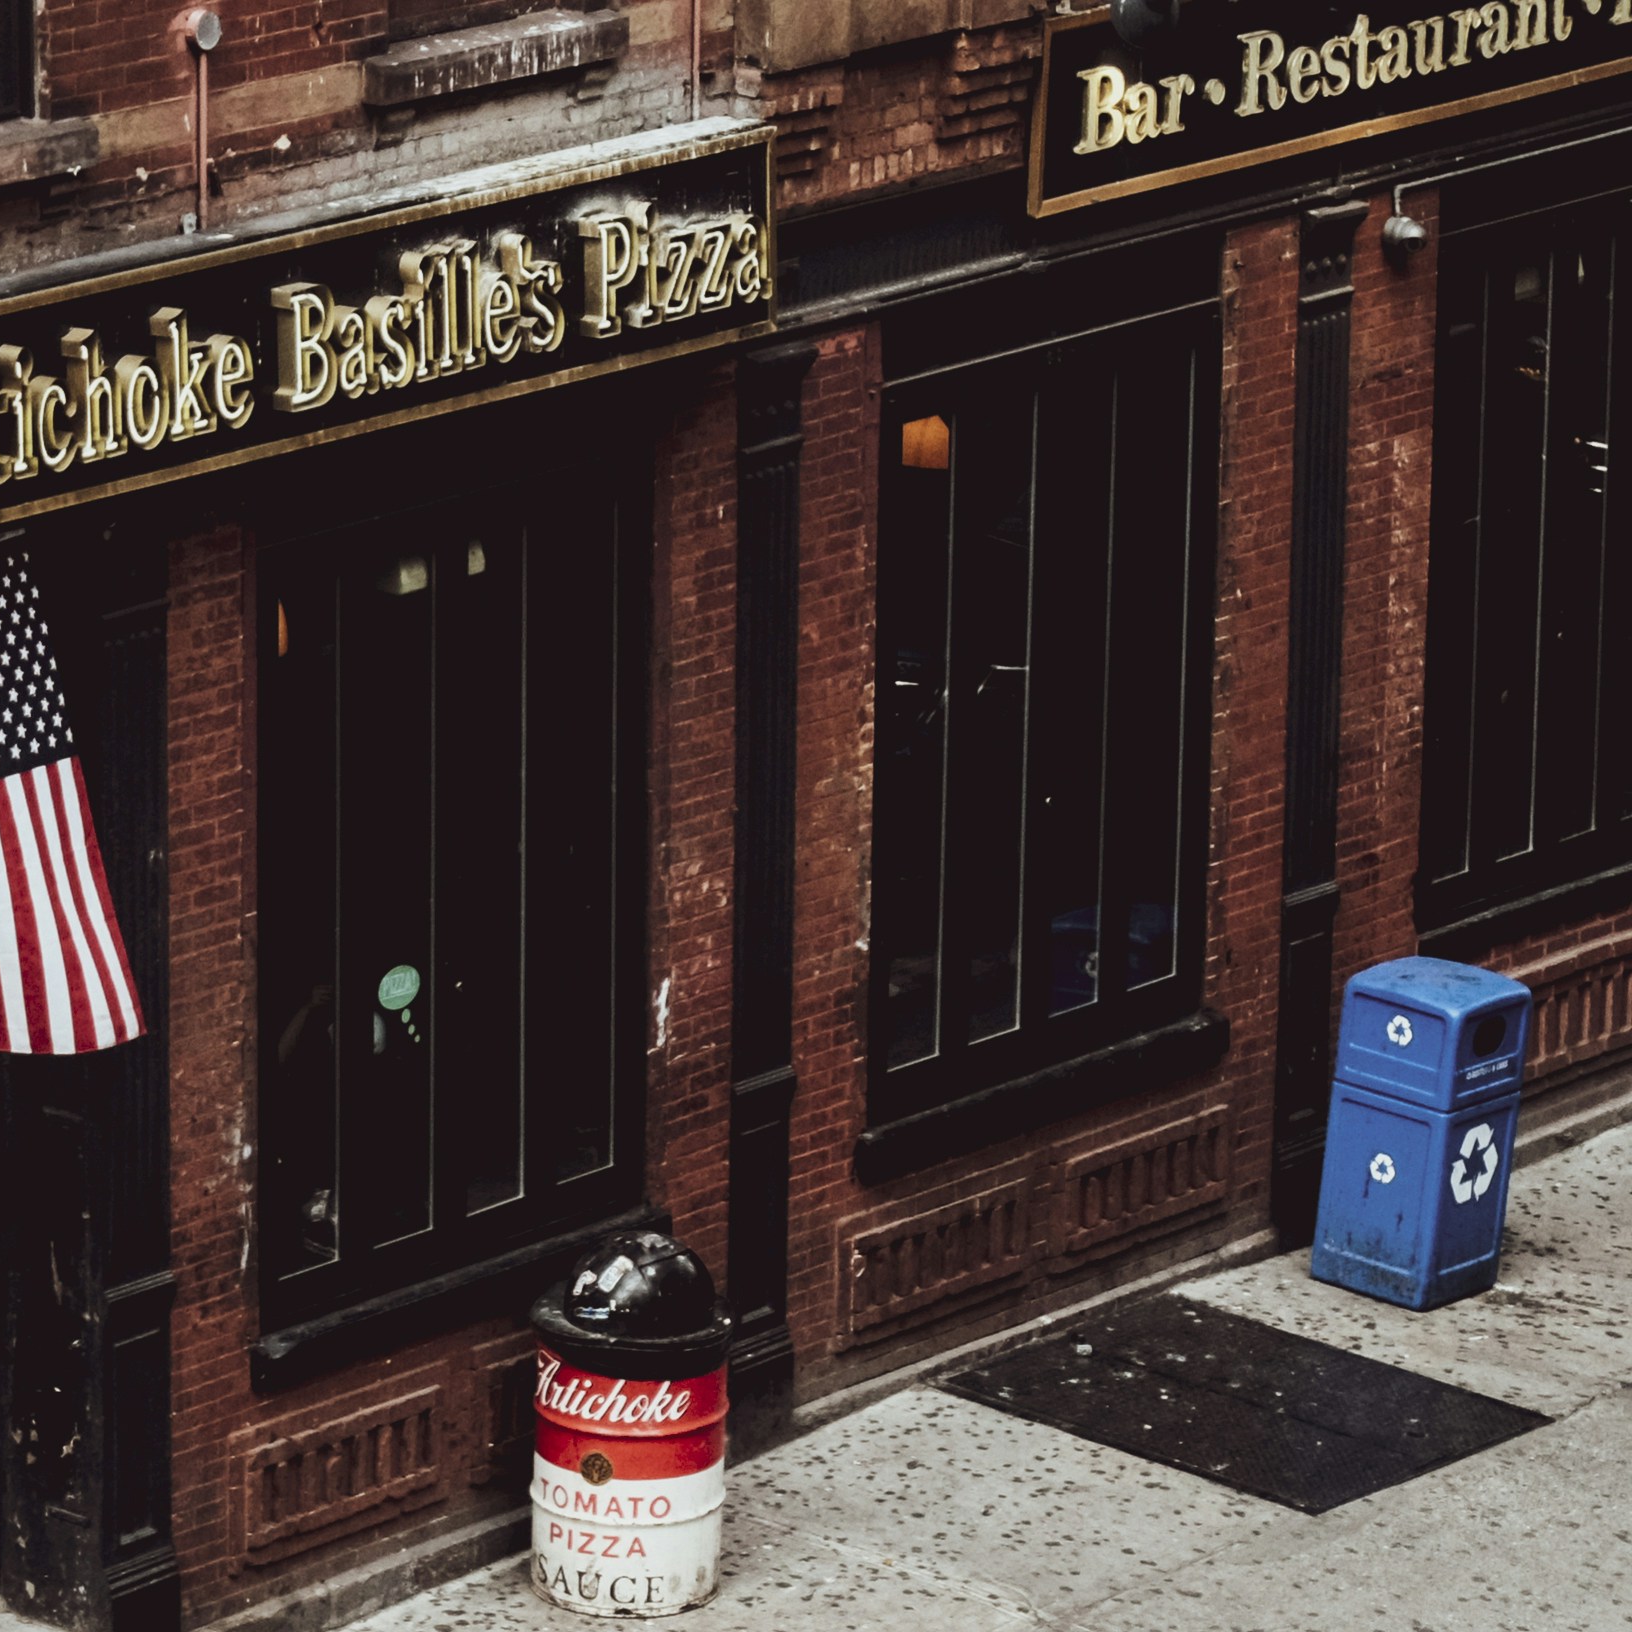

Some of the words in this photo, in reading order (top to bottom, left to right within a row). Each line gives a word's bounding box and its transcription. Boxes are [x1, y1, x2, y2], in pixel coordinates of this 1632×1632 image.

[1073, 65, 1195, 155] Bar
[1234, 0, 1572, 118] Restaurant
[272, 237, 567, 412] Basille's
[578, 200, 770, 338] Pizza
[536, 1349, 691, 1424] Artichoke
[540, 1477, 671, 1520] TOMATO
[549, 1521, 647, 1559] PIZZA
[537, 1552, 665, 1604] SAUCE
